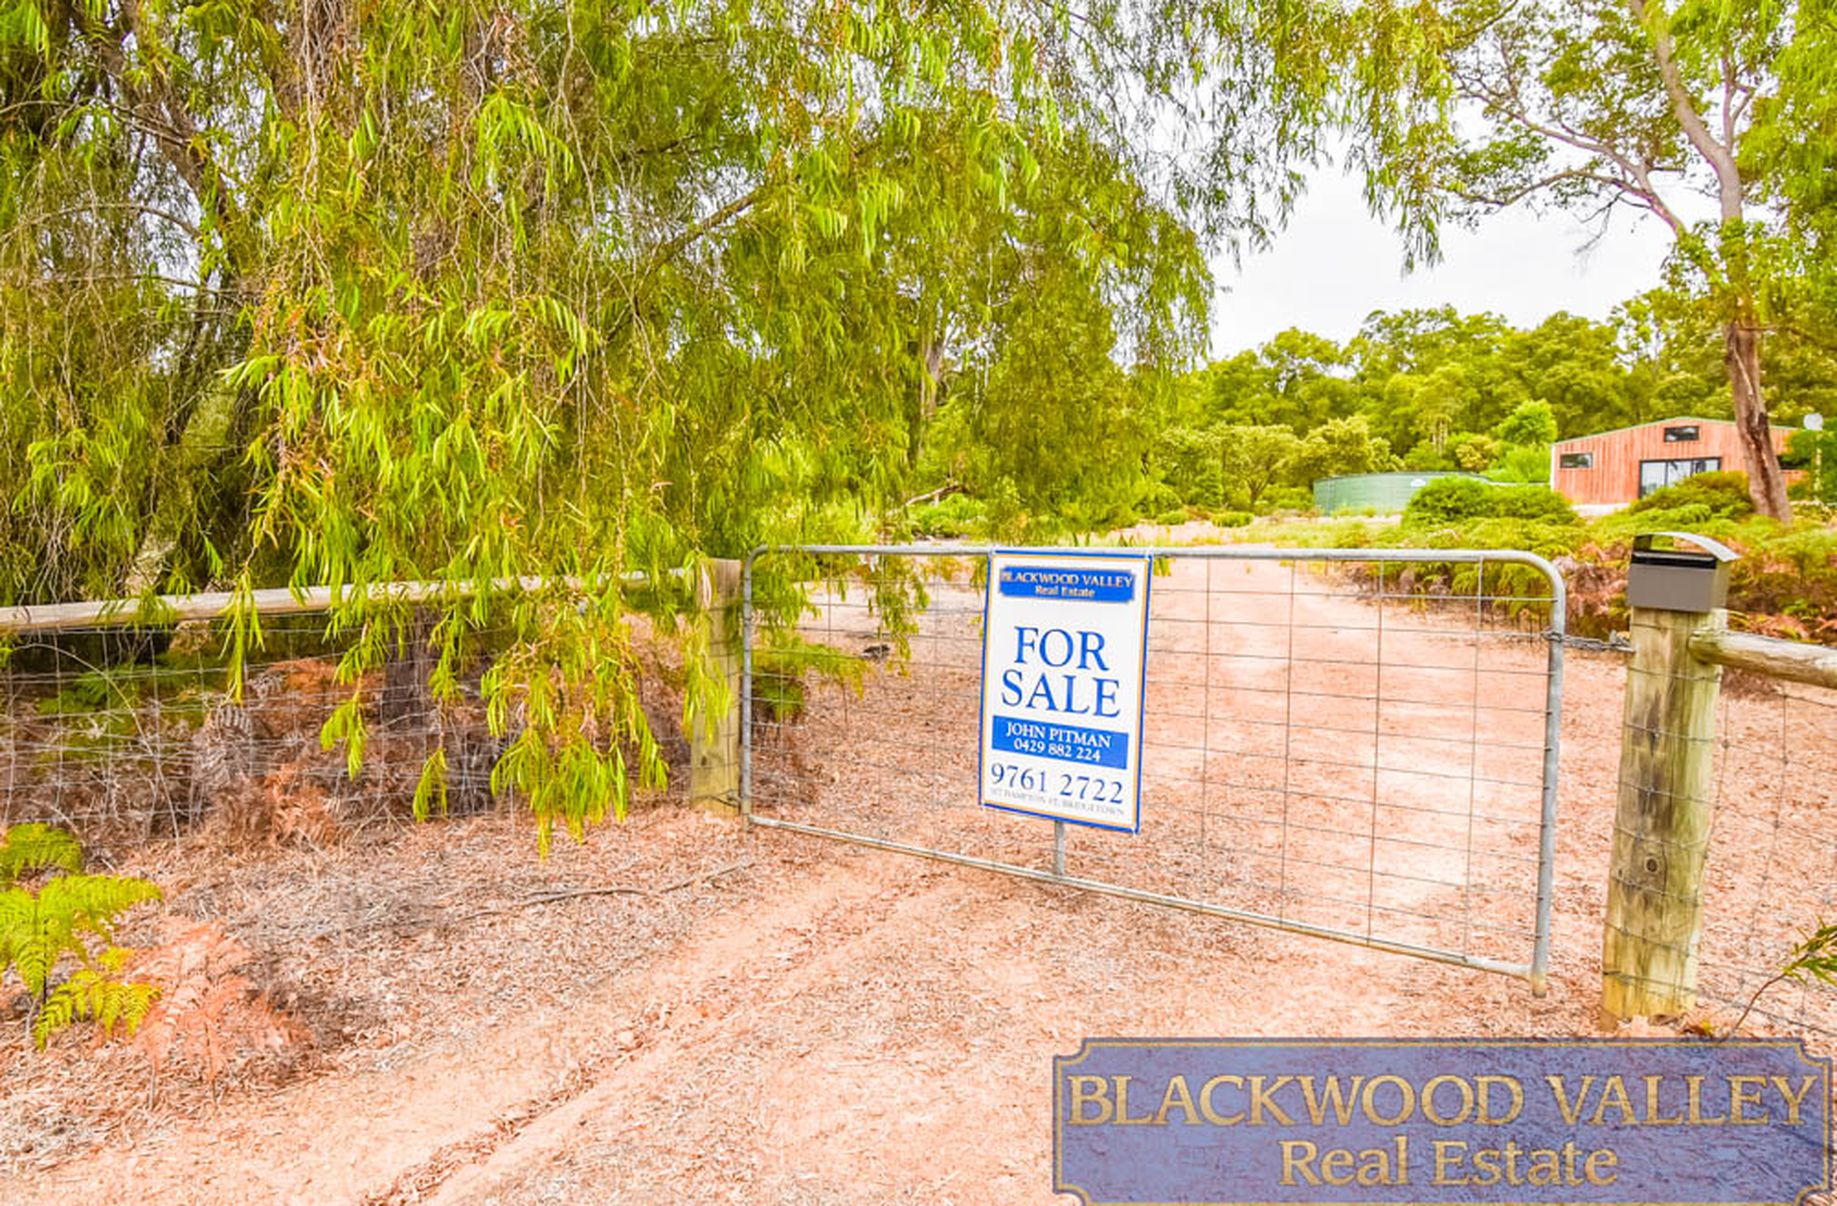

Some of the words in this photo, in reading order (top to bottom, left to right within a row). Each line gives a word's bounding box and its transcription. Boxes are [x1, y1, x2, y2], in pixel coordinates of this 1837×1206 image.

[1001, 571, 1079, 585] BLACKWOOD
[1082, 574, 1133, 588] VALLEY
[1035, 585, 1059, 595] Real
[1061, 586, 1095, 597] Estate
[1014, 626, 1110, 671] FOR
[1001, 669, 1120, 718] SALE
[1006, 721, 1046, 738] JOHN
[1050, 728, 1112, 748] PITMAN
[1014, 738, 1046, 753] 0429
[1048, 744, 1072, 758] 882
[1076, 748, 1101, 762] 224
[991, 762, 1046, 793] 9761
[1060, 774, 1123, 804] 2722
